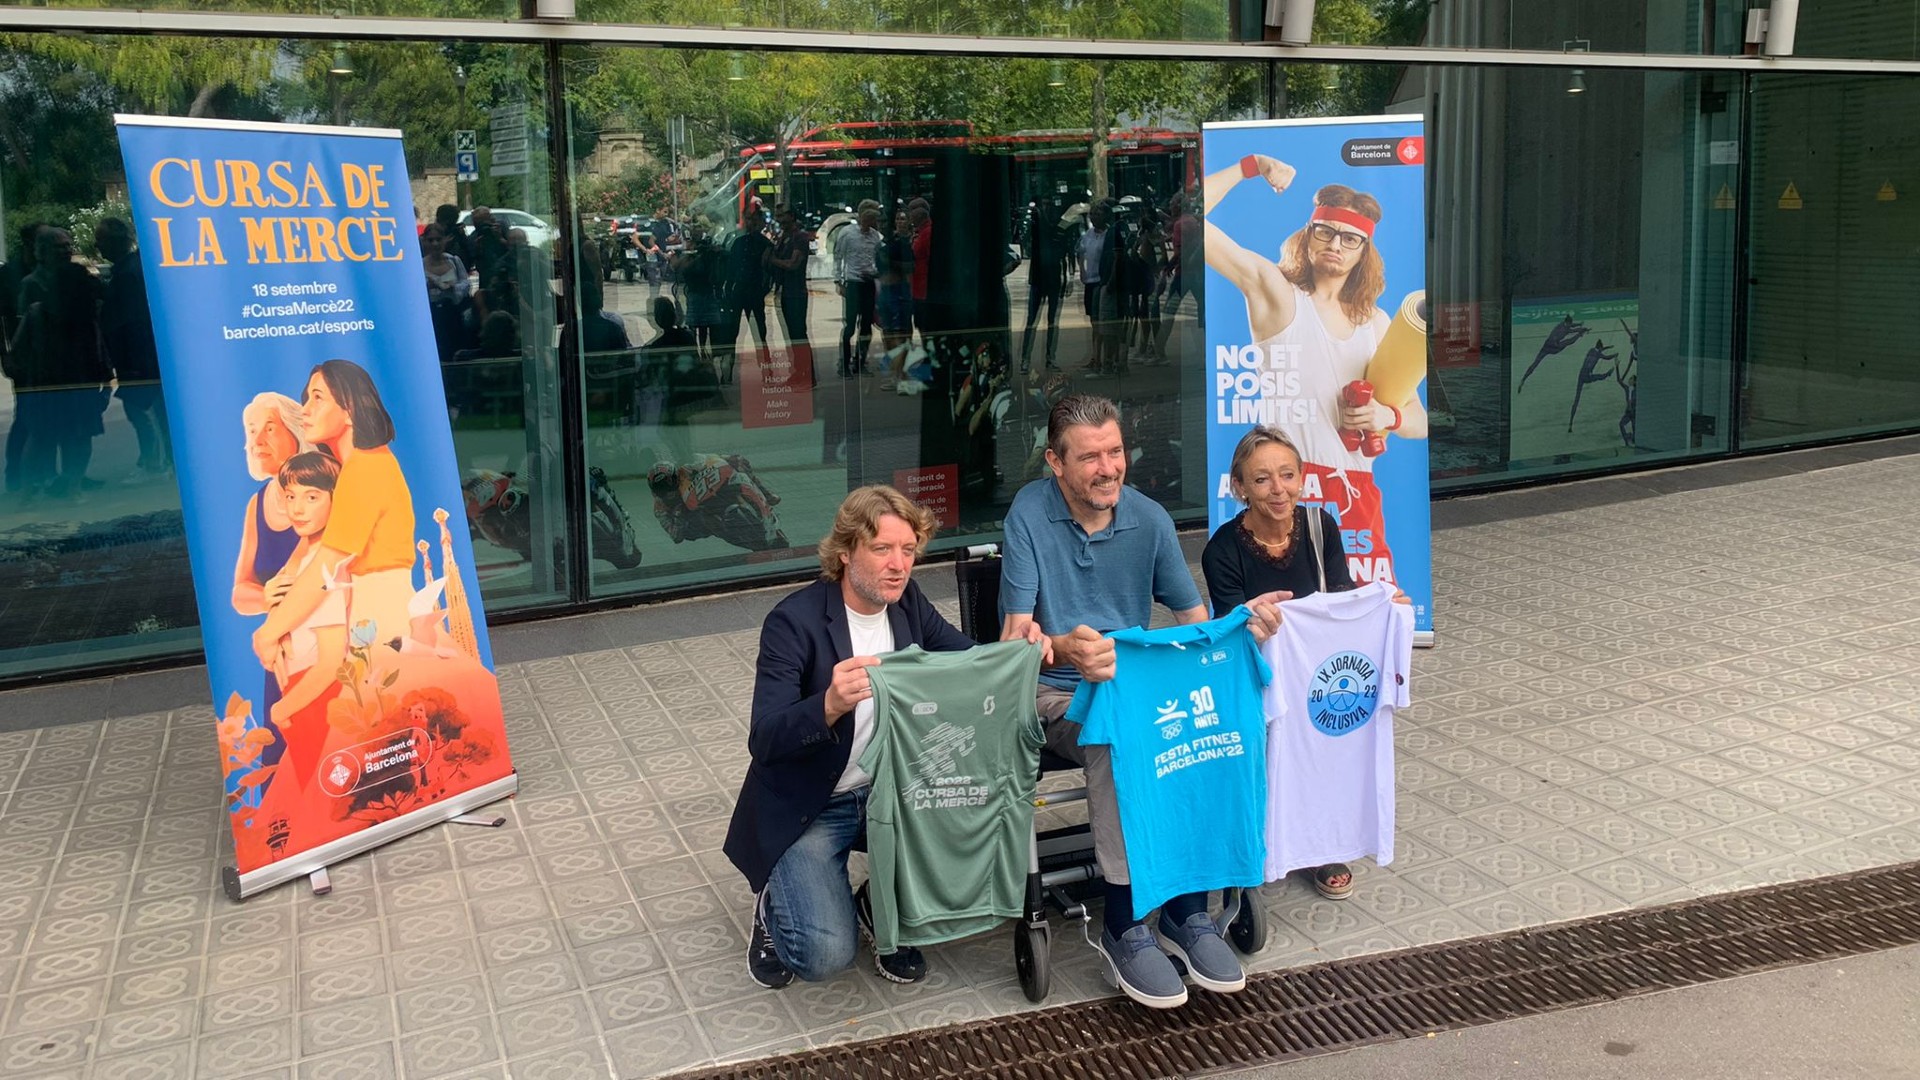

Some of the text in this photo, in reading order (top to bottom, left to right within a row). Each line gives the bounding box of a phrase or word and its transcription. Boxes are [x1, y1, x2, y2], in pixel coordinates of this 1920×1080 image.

[1350, 151, 1391, 159] Barcelona
[149, 157, 389, 208] CURSA DE
[151, 210, 404, 267] LA MERCÈ
[252, 280, 337, 298] 18 setembre
[241, 299, 355, 319] #CursaMercè22
[223, 318, 375, 340] barcelona.cat/esports
[1216, 344, 1303, 370] NO ET
[765, 375, 789, 383] Hacer
[1216, 371, 1301, 397] POSIS
[762, 386, 792, 394] historia
[766, 400, 789, 409] Make
[1216, 393, 1318, 424] LÍMITS!
[764, 411, 792, 420] history
[907, 474, 934, 484] Esperit
[908, 483, 945, 494] superació
[1317, 655, 1375, 684] IX JORNADA
[1189, 685, 1215, 716] 30
[1311, 684, 1377, 703] 20 22
[1193, 712, 1220, 730] ANYS
[1315, 705, 1370, 730] INCLUSIVA
[363, 738, 415, 761] Ajuntament de
[1154, 731, 1242, 768] FESTA FITNES
[365, 749, 418, 774] Barcelona
[1156, 744, 1245, 779] BARCELONA'22
[936, 776, 972, 787] 2022
[915, 786, 988, 799] CURSA DE
[914, 799, 932, 811] LA
